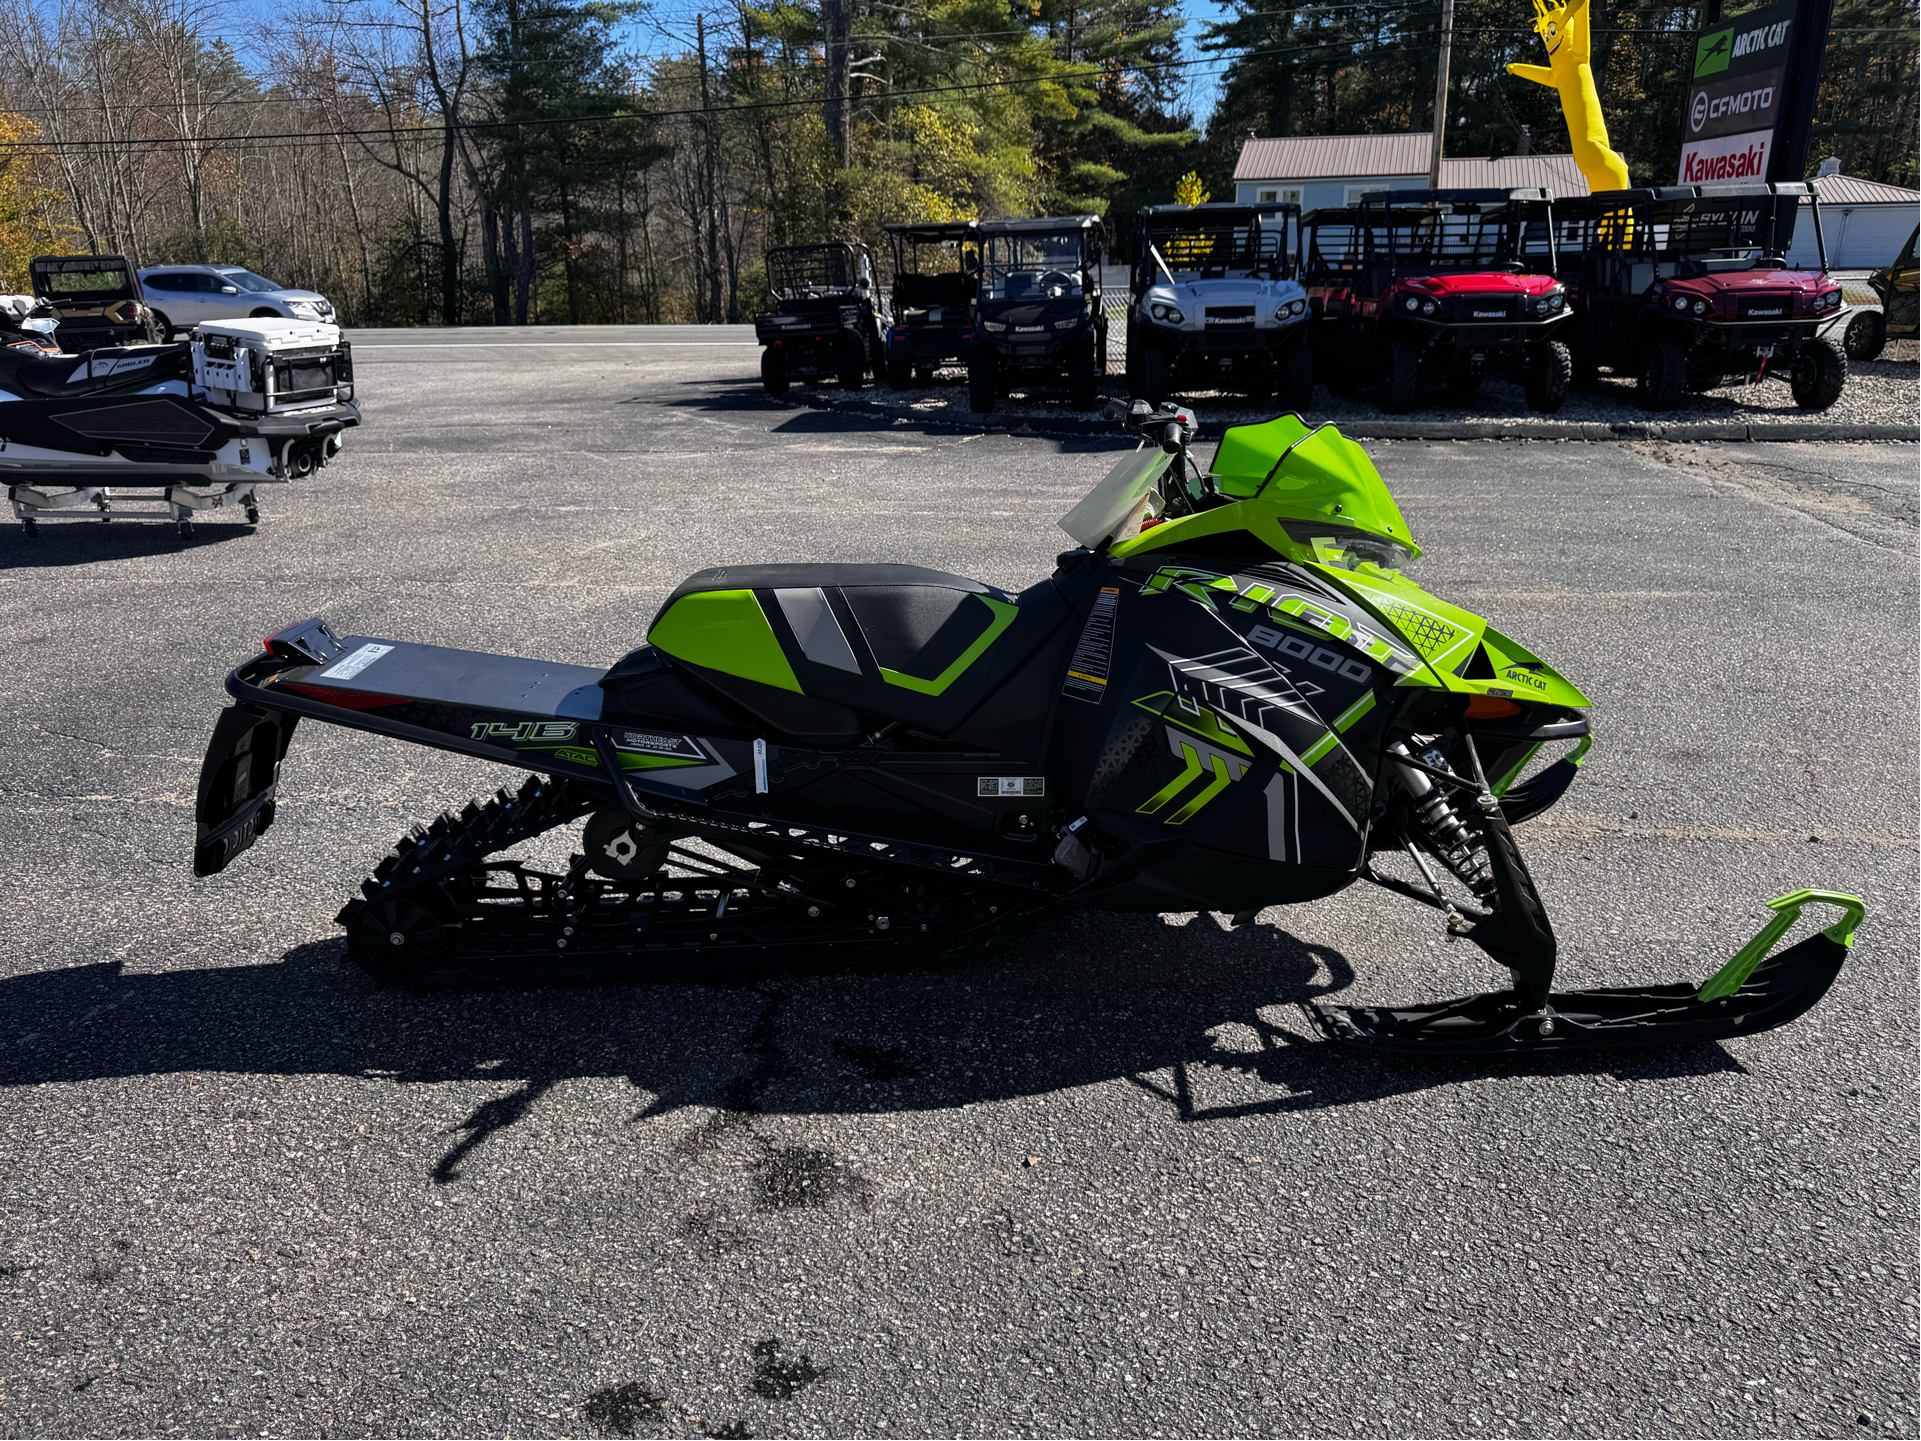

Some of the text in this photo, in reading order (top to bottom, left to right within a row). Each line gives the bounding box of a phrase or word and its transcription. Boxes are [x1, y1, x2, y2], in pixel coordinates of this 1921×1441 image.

[1731, 20, 1790, 58] ARCTIC CAT
[1709, 87, 1773, 118] CFMOTO
[1683, 142, 1765, 183] Kawasaki
[1473, 310, 1507, 318] Kawasaki
[1747, 308, 1783, 316] Kawasaki
[781, 322, 812, 331] Kawasaki
[1214, 316, 1246, 324] Kawasaki
[1015, 324, 1045, 333] Kawasaki
[116, 358, 150, 369] ANGLER
[1138, 565, 1417, 664] RIOT
[1246, 624, 1373, 686] 8000
[1505, 669, 1547, 692] ARCTIC CAT
[470, 721, 580, 741] 146
[624, 731, 682, 746] NORTHEAST
[625, 738, 677, 749] MOTORSPORTS
[555, 750, 597, 764] ATAC
